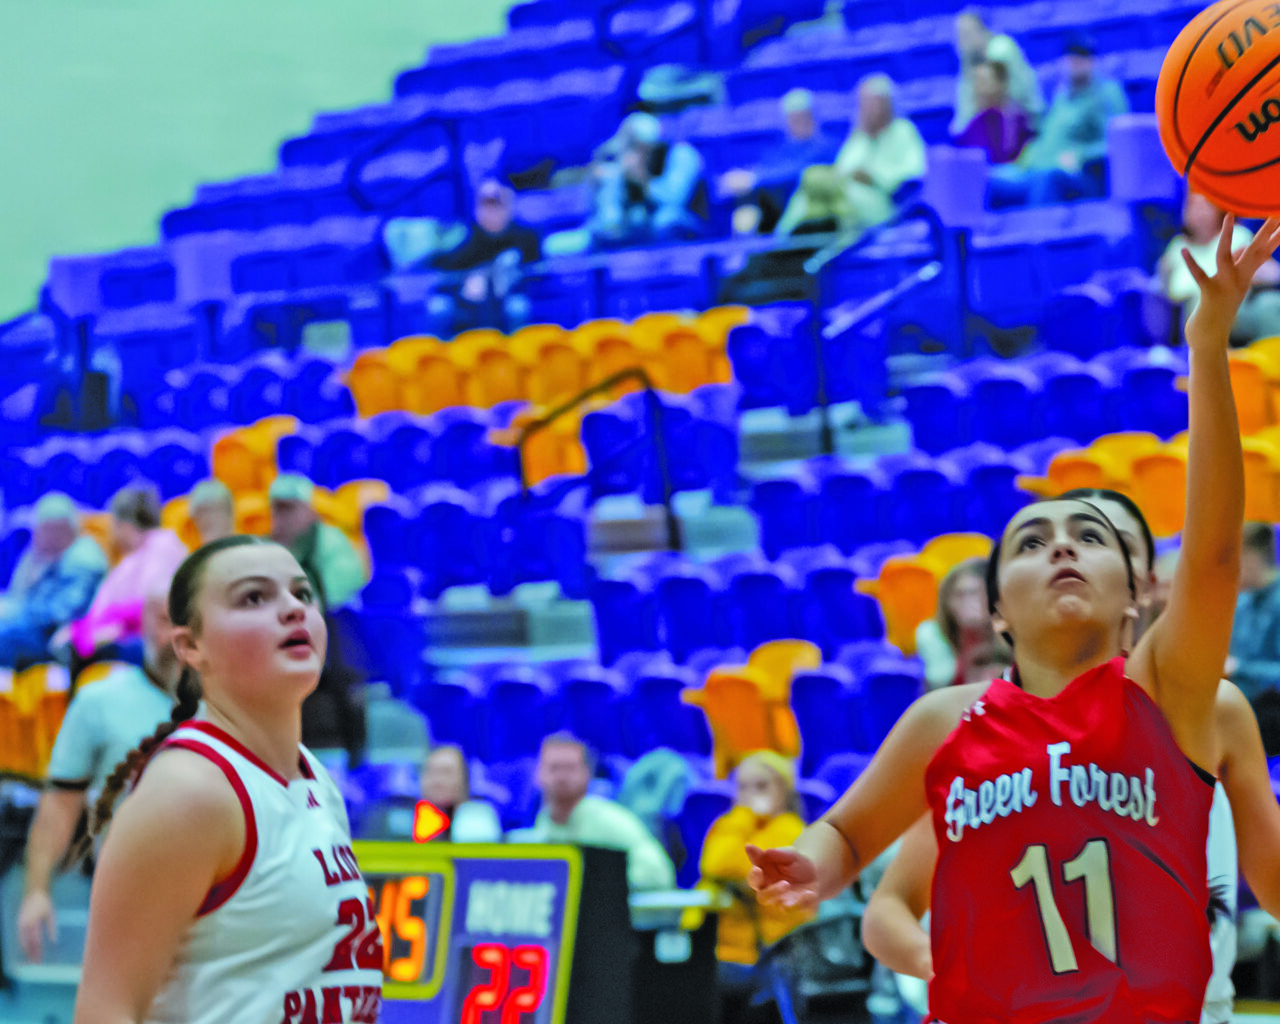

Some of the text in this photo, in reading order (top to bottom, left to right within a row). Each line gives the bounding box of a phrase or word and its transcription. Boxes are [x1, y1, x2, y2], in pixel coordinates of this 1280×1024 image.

[944, 741, 1160, 842] Green Forest
[1008, 836, 1124, 977] 11
